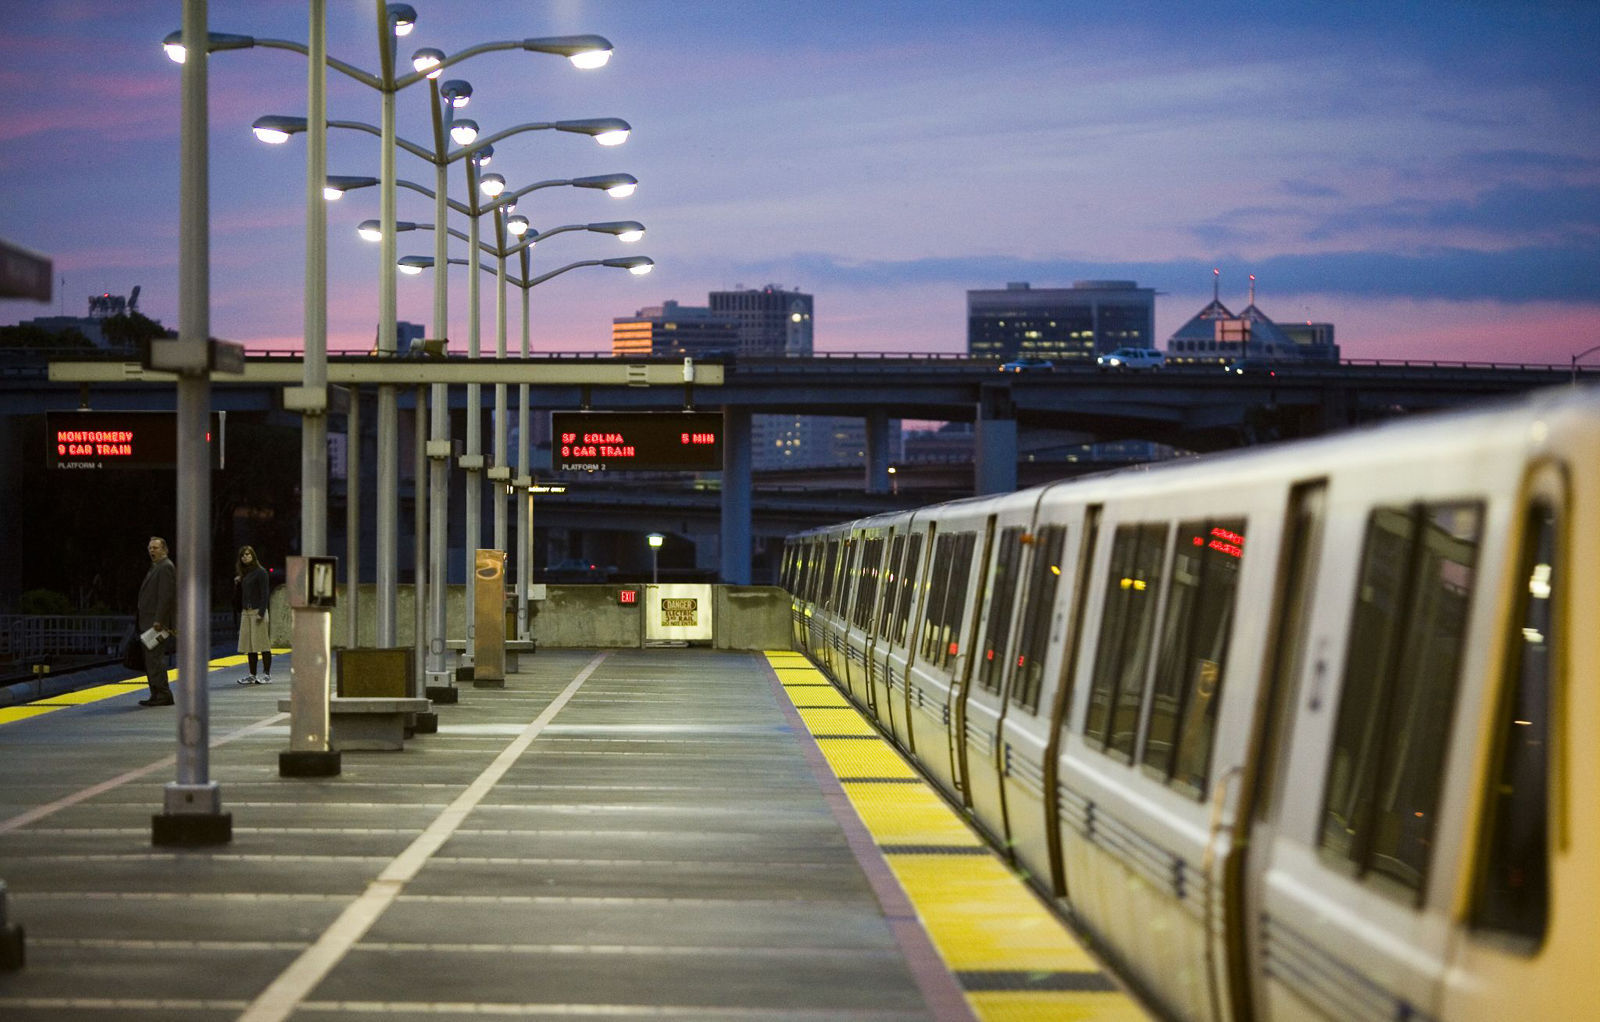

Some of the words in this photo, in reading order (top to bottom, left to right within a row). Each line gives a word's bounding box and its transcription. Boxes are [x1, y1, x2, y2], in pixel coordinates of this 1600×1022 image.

[58, 431, 133, 442] MONTGOMERY
[562, 433, 577, 444] SF
[584, 433, 624, 444] COLMA
[681, 433, 689, 444] 5
[693, 433, 715, 444] MIN
[69, 444, 93, 455] CAR
[96, 444, 132, 455] TRAIN
[573, 446, 597, 457] CAR
[600, 446, 635, 457] TRAIN
[621, 591, 636, 603] EXIT
[667, 600, 692, 609] DANGER
